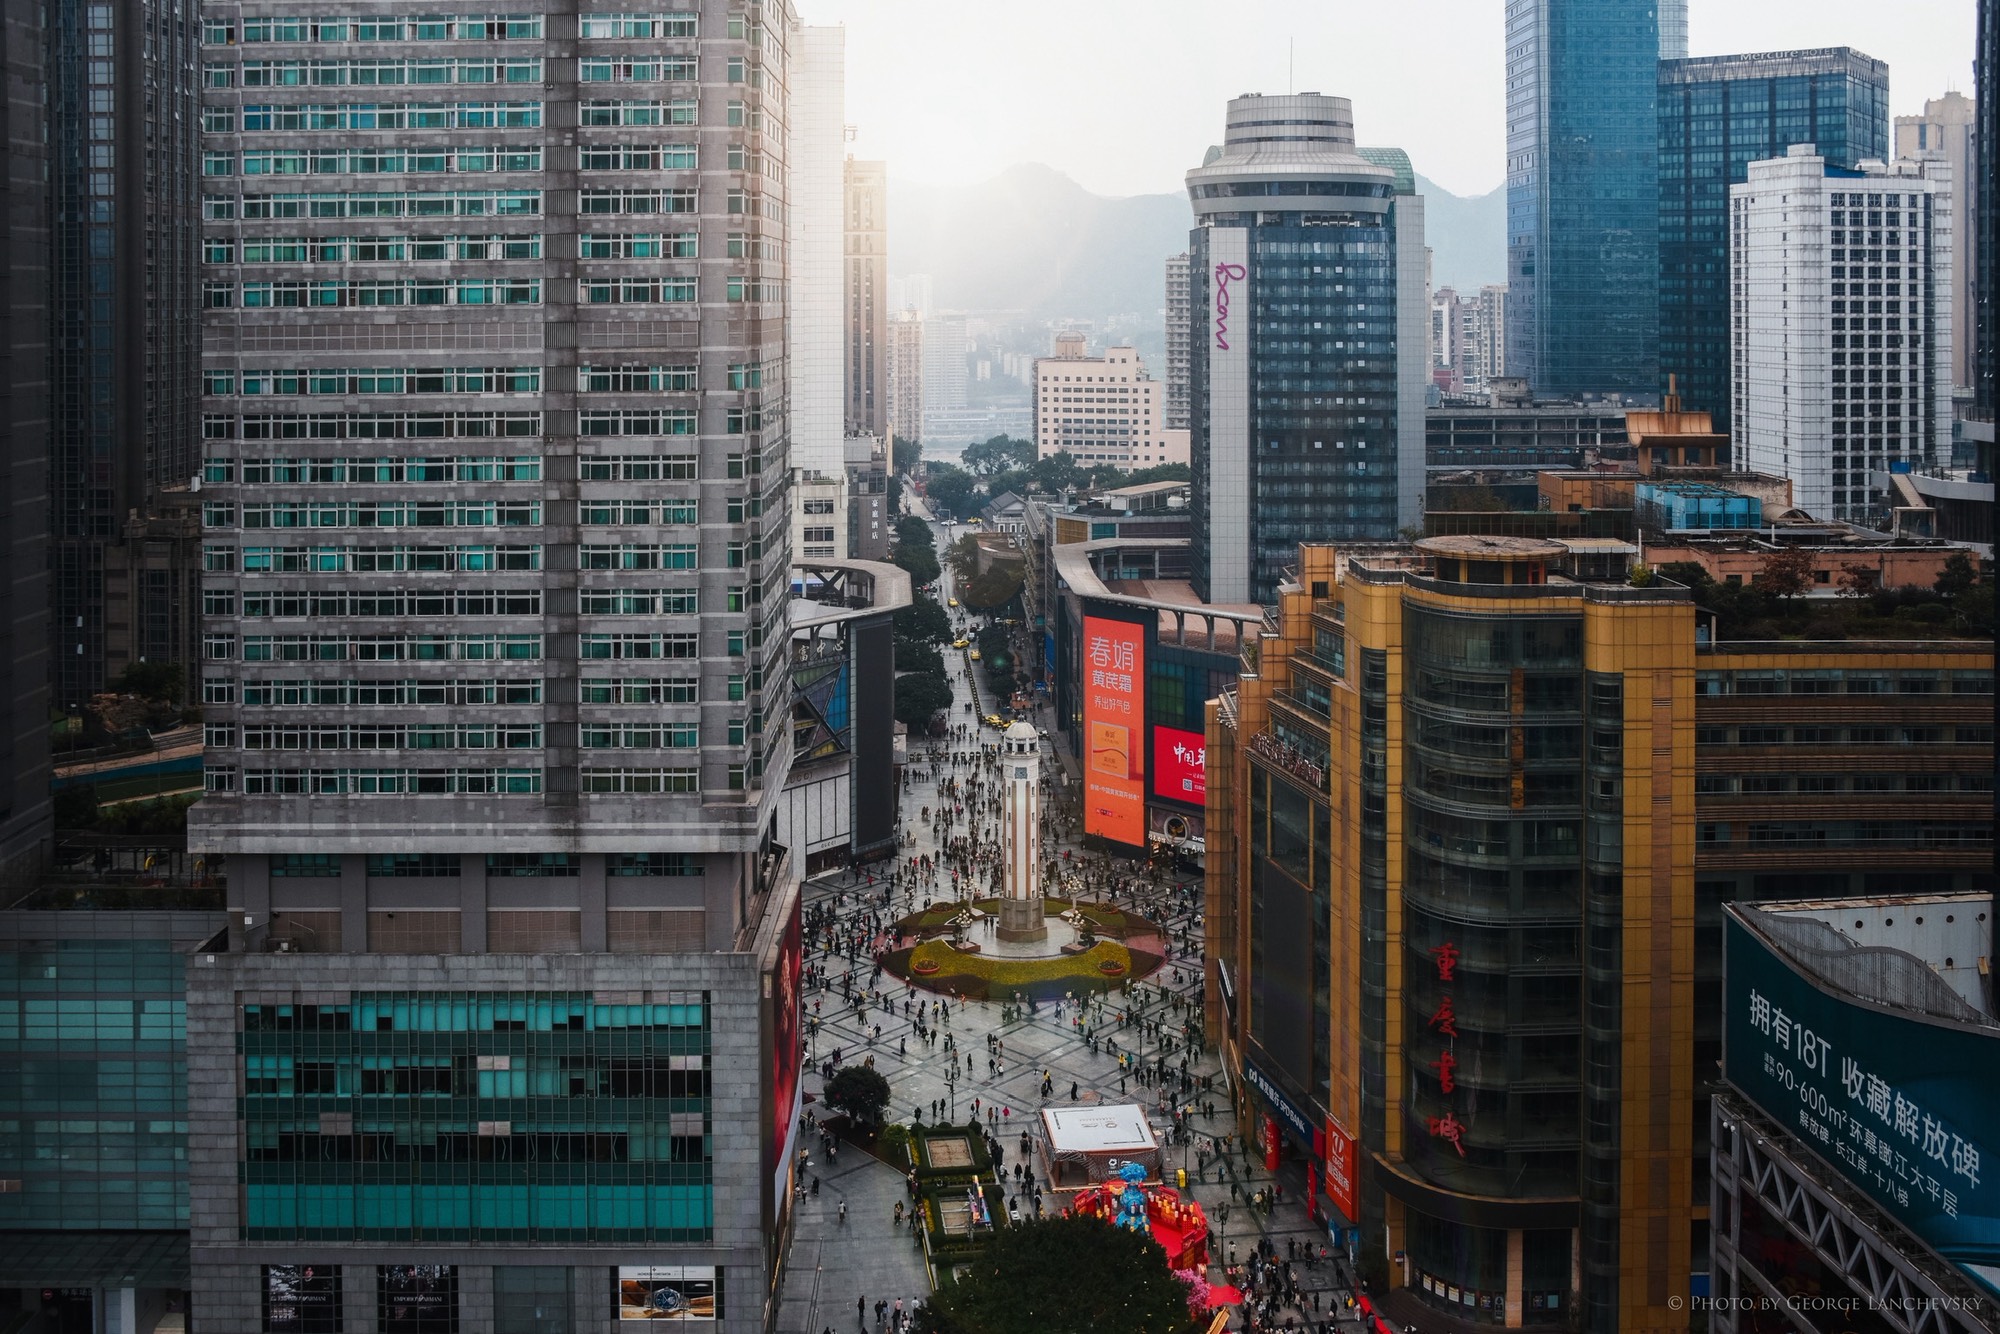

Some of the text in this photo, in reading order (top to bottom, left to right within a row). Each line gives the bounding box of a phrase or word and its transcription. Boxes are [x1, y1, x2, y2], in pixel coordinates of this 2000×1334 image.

[1740, 50, 1799, 61] Mercure
[1801, 47, 1838, 57] HOTEL
[1090, 637, 1134, 671] 春娟
[1092, 670, 1132, 693] 黄芪霜
[1750, 988, 1981, 1190] 拥有18T 收藏解放碑
